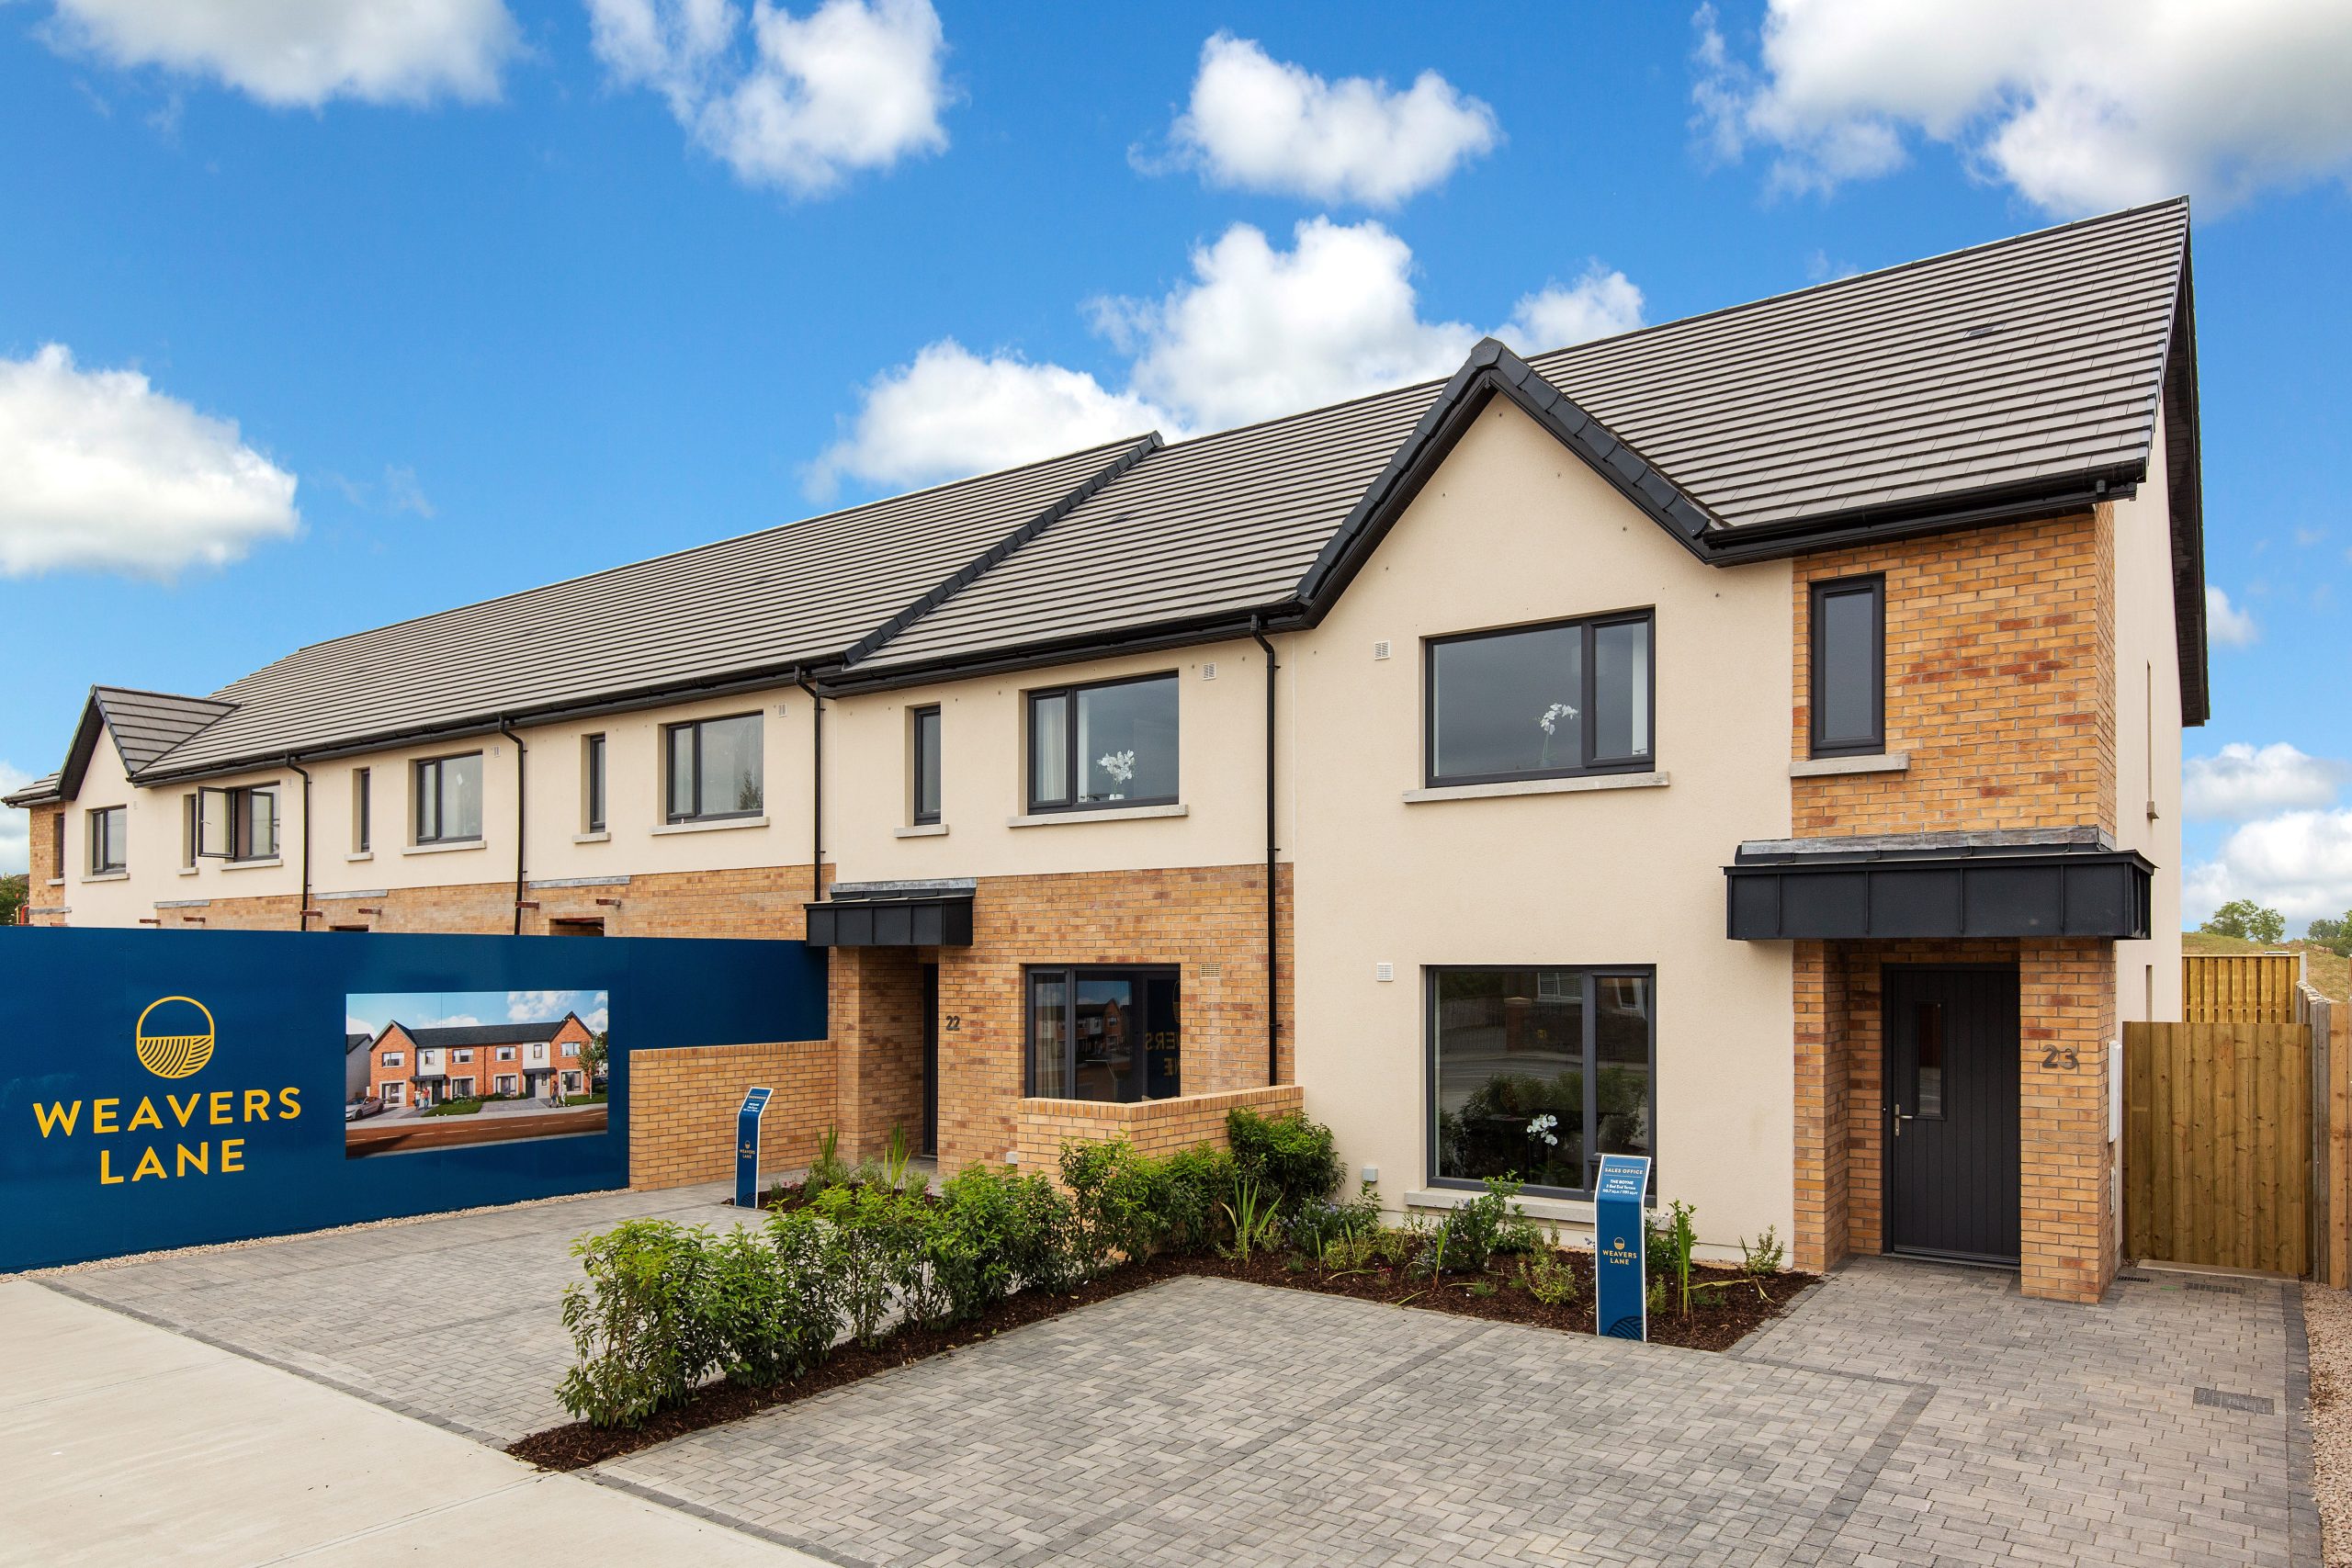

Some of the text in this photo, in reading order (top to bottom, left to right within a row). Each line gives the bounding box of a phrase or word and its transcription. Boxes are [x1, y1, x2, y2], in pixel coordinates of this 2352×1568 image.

[946, 1015, 960, 1031] 22
[2042, 1043, 2079, 1069] 23
[32, 1087, 301, 1138] WEAVERS
[100, 1138, 244, 1185] LANE
[1602, 1249, 1637, 1258] WEAVERS
